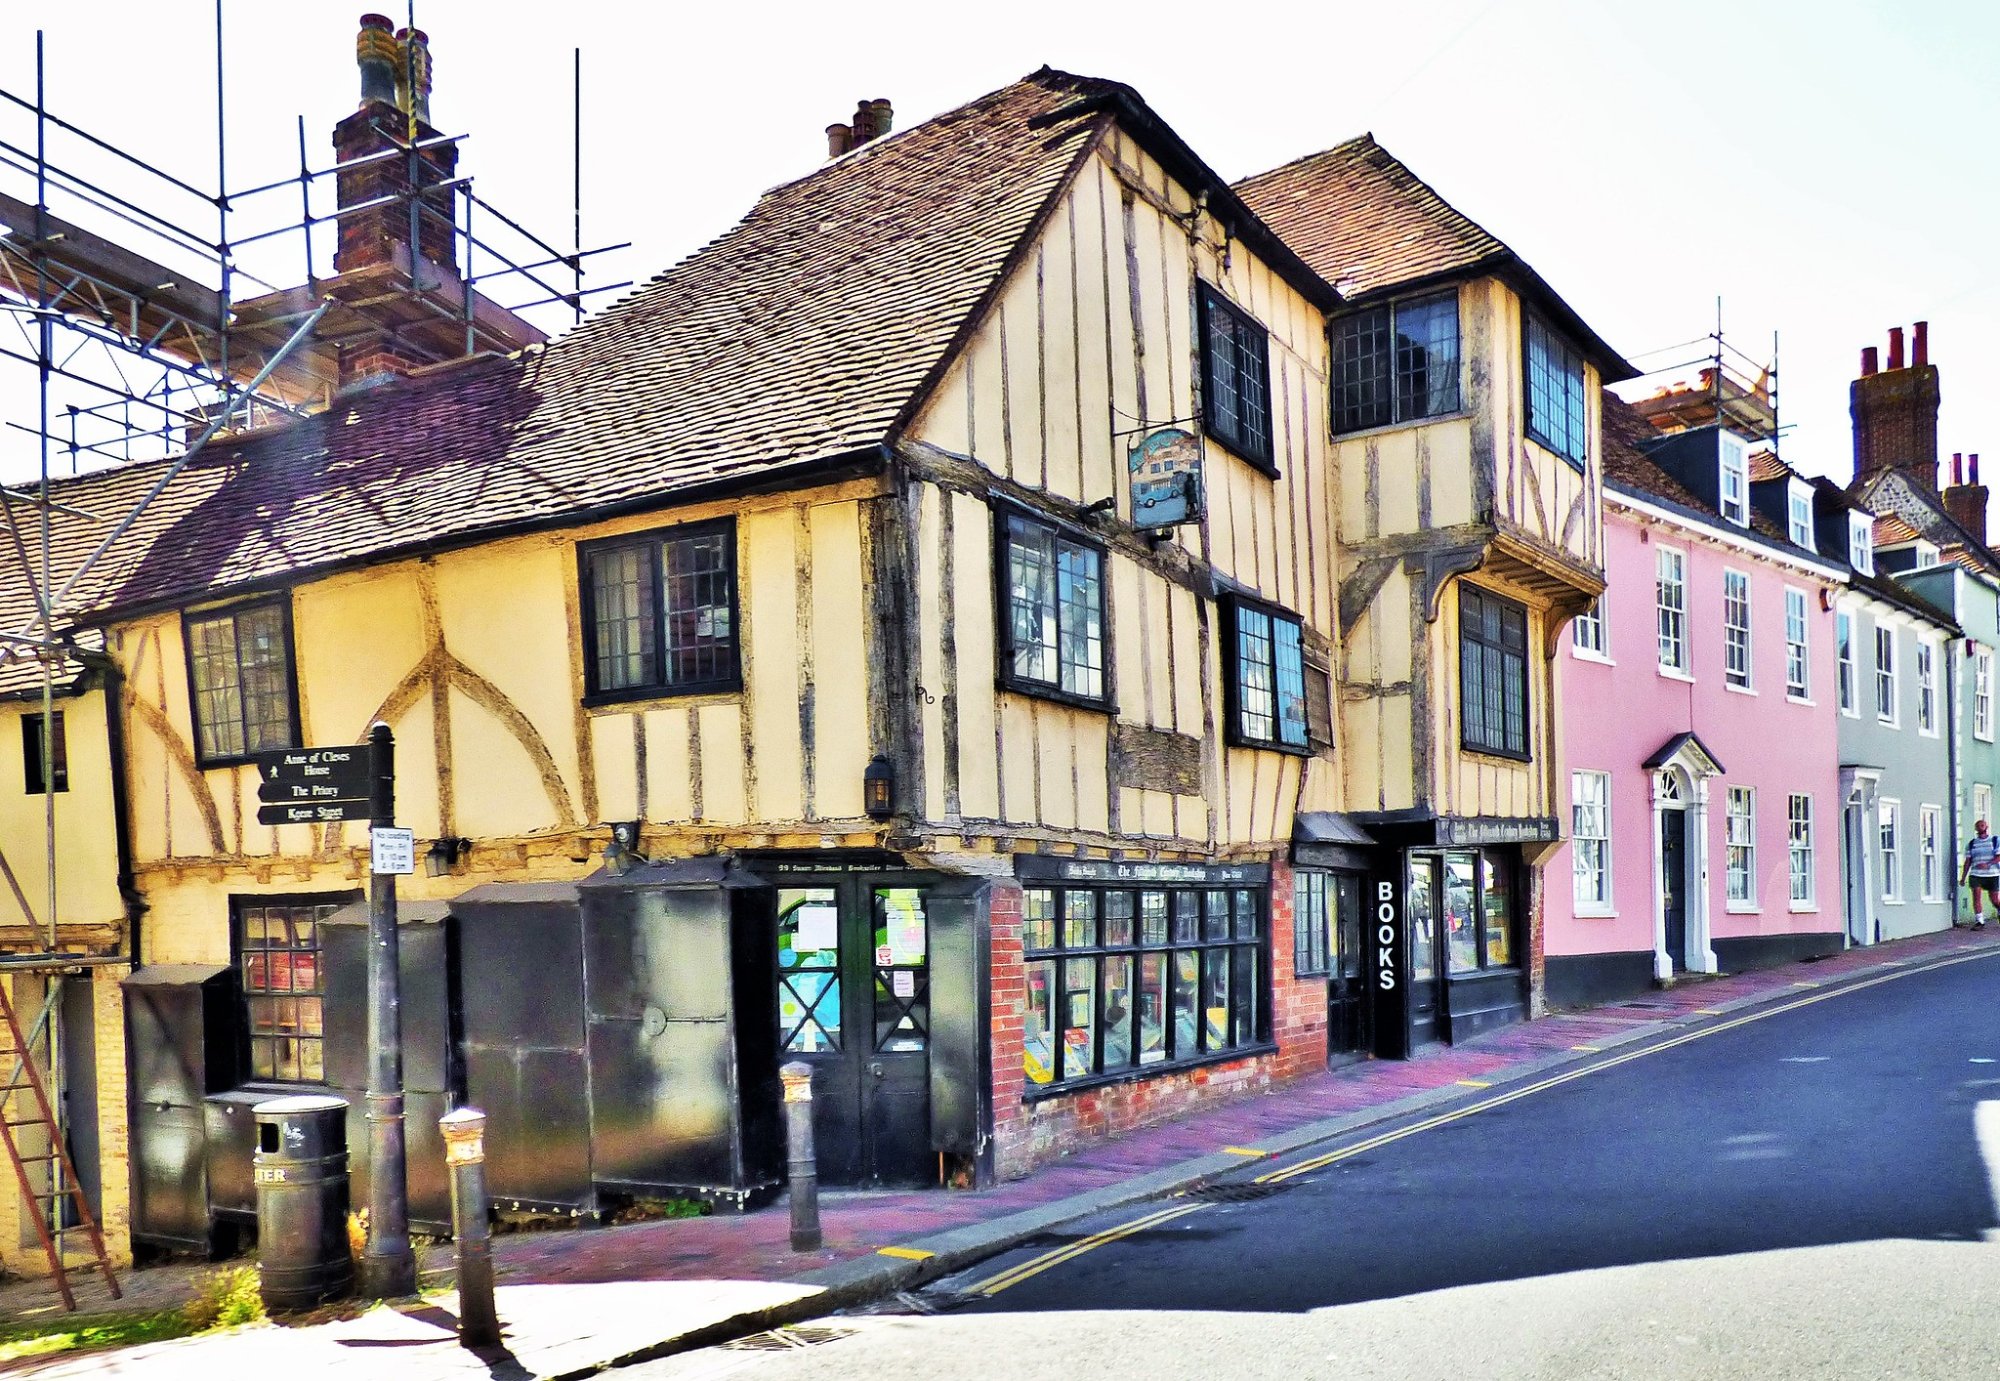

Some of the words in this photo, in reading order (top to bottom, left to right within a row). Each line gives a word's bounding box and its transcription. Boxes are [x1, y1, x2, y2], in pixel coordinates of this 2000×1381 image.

[284, 755, 307, 765] Anne
[309, 752, 320, 763] of
[322, 751, 351, 762] Cleves
[304, 765, 330, 776] House
[291, 786, 309, 796] The
[312, 785, 339, 797] Priory
[317, 807, 343, 818] Street
[1118, 864, 1131, 877] The
[1378, 881, 1395, 990] BOOKS
